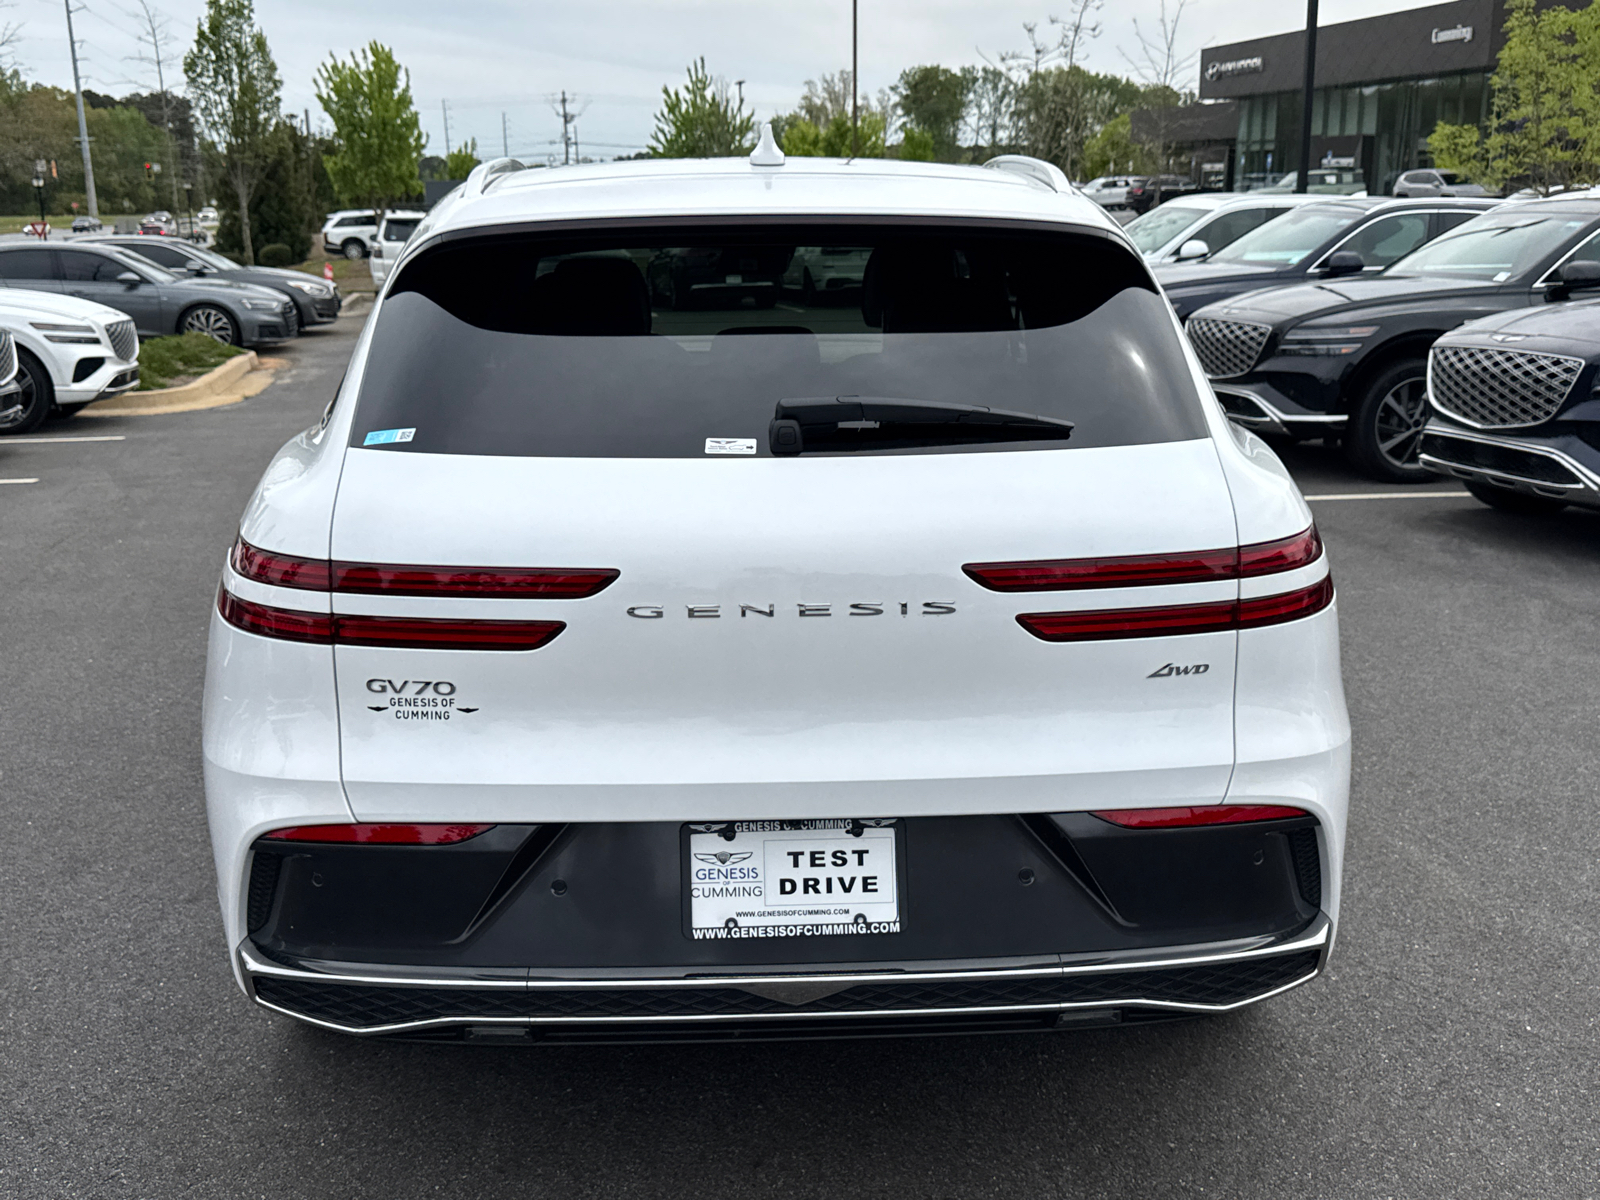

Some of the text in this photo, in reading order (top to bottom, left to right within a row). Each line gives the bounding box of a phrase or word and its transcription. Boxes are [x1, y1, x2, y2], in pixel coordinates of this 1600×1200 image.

[626, 600, 957, 619] GENESIS
[366, 678, 456, 696] GV70
[389, 697, 455, 708] GENESIS OF
[395, 710, 450, 721] CUMMING
[734, 821, 781, 832] GENESIS
[787, 849, 869, 868] TEST
[695, 867, 759, 881] GENESIS
[691, 886, 763, 898] CUMMING
[779, 875, 879, 895] DRIVE
[735, 908, 850, 918] WWW.GENESISOFCUMMING.COM
[692, 922, 901, 940] WWW.GENESISOFCUMMING.COM
